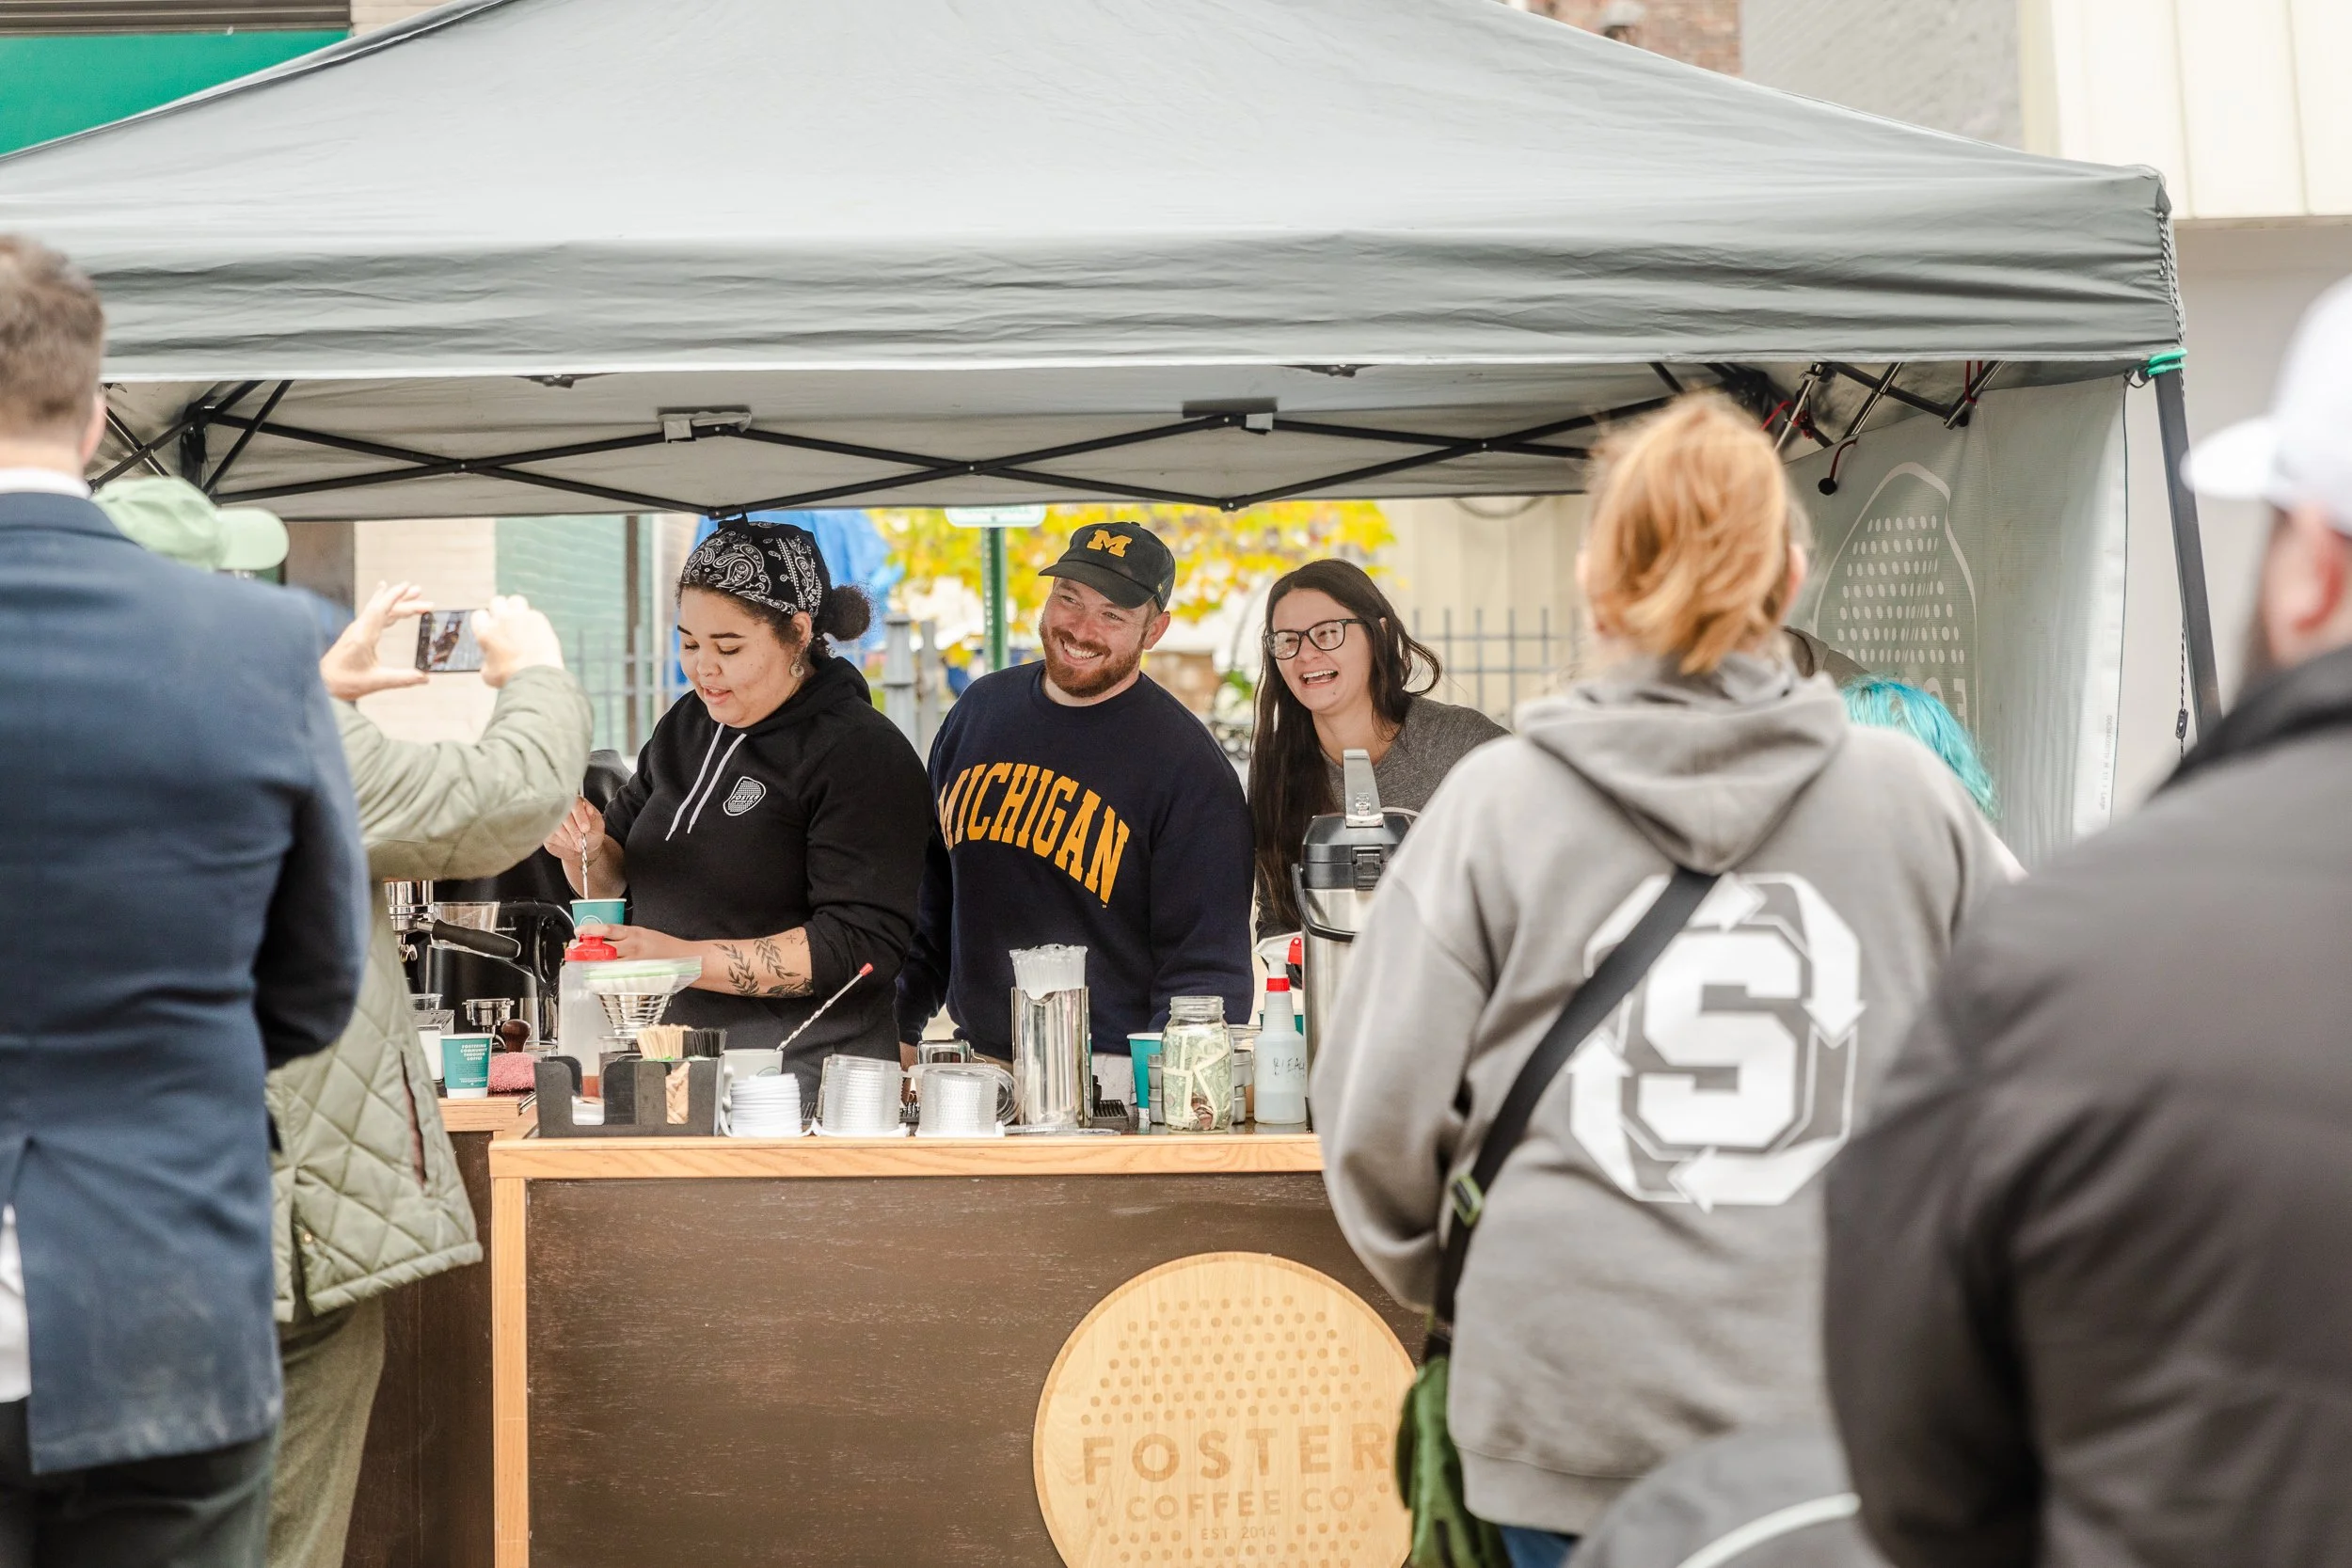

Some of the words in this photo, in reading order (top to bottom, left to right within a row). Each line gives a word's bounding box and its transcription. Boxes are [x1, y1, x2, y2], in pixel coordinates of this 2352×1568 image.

[1086, 529, 1132, 558] M
[938, 761, 1130, 903] MICHIGAN
[1637, 929, 1802, 1148] S
[1082, 1422, 1389, 1485] FOSTER
[1128, 1489, 1281, 1522] COFFEE
[1300, 1485, 1355, 1513] CO
[1200, 1528, 1230, 1541] EST
[1241, 1526, 1277, 1539] 2014
